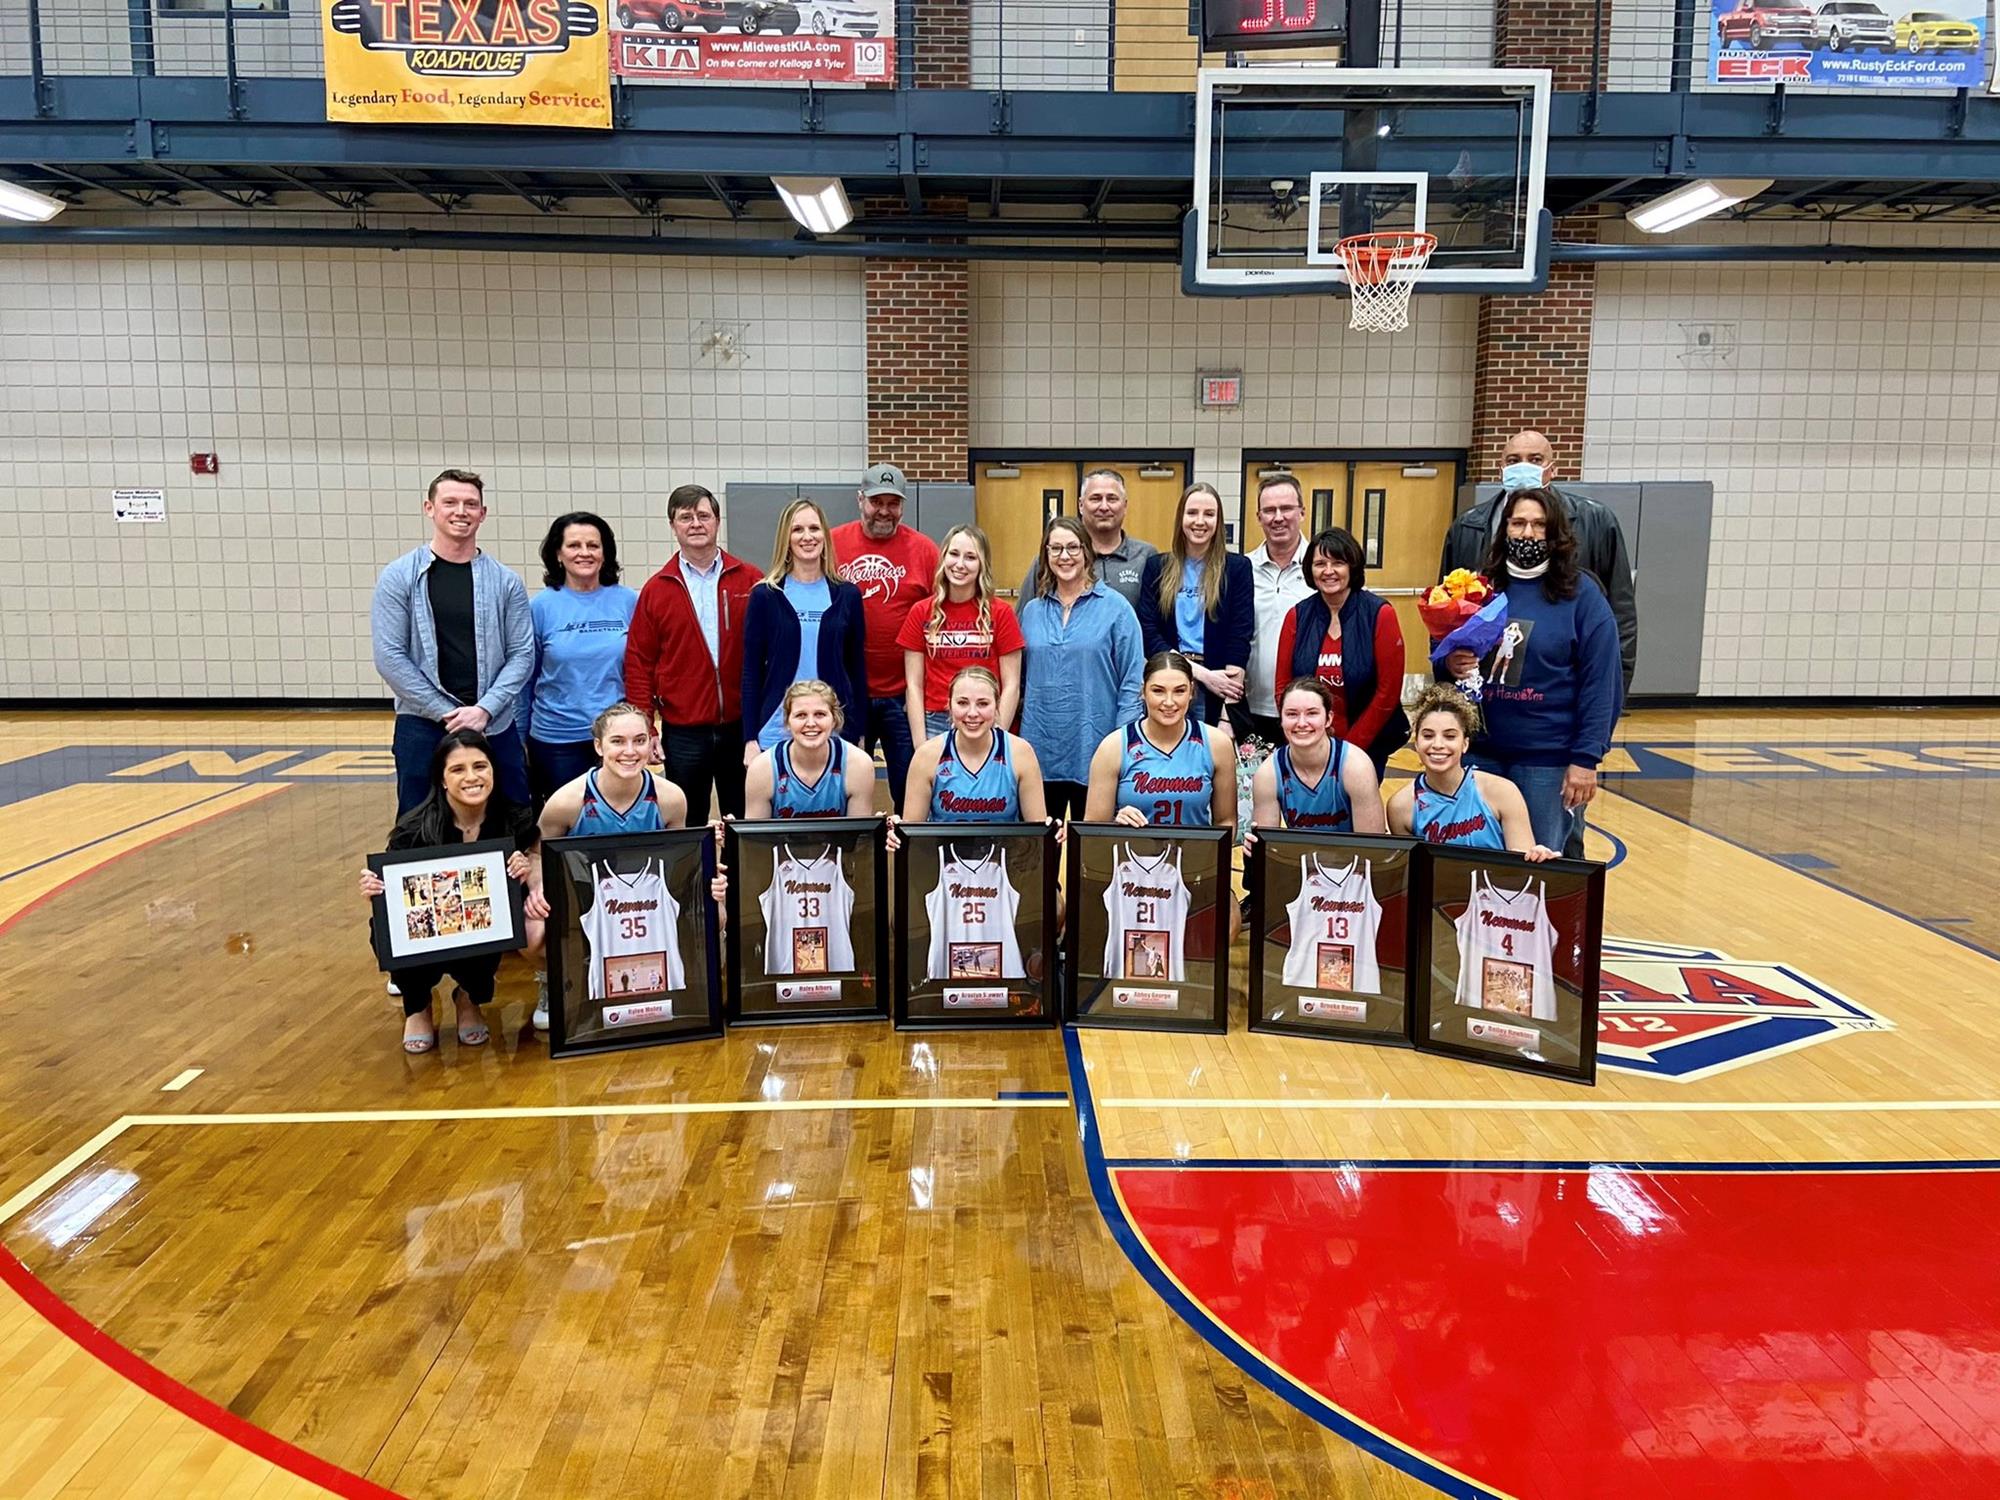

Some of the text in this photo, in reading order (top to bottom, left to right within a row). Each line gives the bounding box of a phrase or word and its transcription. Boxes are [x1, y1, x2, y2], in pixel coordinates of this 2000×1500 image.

[374, 0, 561, 45] TEXAS
[624, 36, 699, 46] MIDWEST
[710, 41, 841, 54] www.MidwestKIA.com
[411, 50, 525, 71] ROADHOUSE
[626, 46, 697, 67] KIA
[857, 45, 877, 61] 10
[706, 58, 719, 67] On
[720, 59, 735, 68] the
[737, 59, 766, 68] Corner
[768, 59, 780, 69] of
[780, 59, 812, 70] Kellogg
[814, 60, 822, 68] &
[823, 60, 846, 70] Tyler
[1718, 59, 1811, 76] ECK
[1822, 59, 1966, 73] www.RustyEckFord.com
[332, 89, 605, 109] Legendary Food, Legendary Service.
[1132, 771, 1203, 795] Newman
[939, 790, 1007, 813] Newman
[1153, 800, 1183, 825] 21
[1423, 813, 1486, 844] Newman
[785, 880, 832, 895] Newman
[949, 883, 998, 899] Newman
[1122, 882, 1171, 900] Newman
[605, 899, 658, 915] Newman
[798, 897, 820, 918] 33
[962, 902, 986, 923] 25
[1136, 902, 1155, 923] 21
[1311, 896, 1365, 913] Newman
[620, 916, 647, 939] 35
[1327, 917, 1348, 939] 13
[1480, 910, 1536, 932] Newman
[1501, 934, 1514, 956] 4
